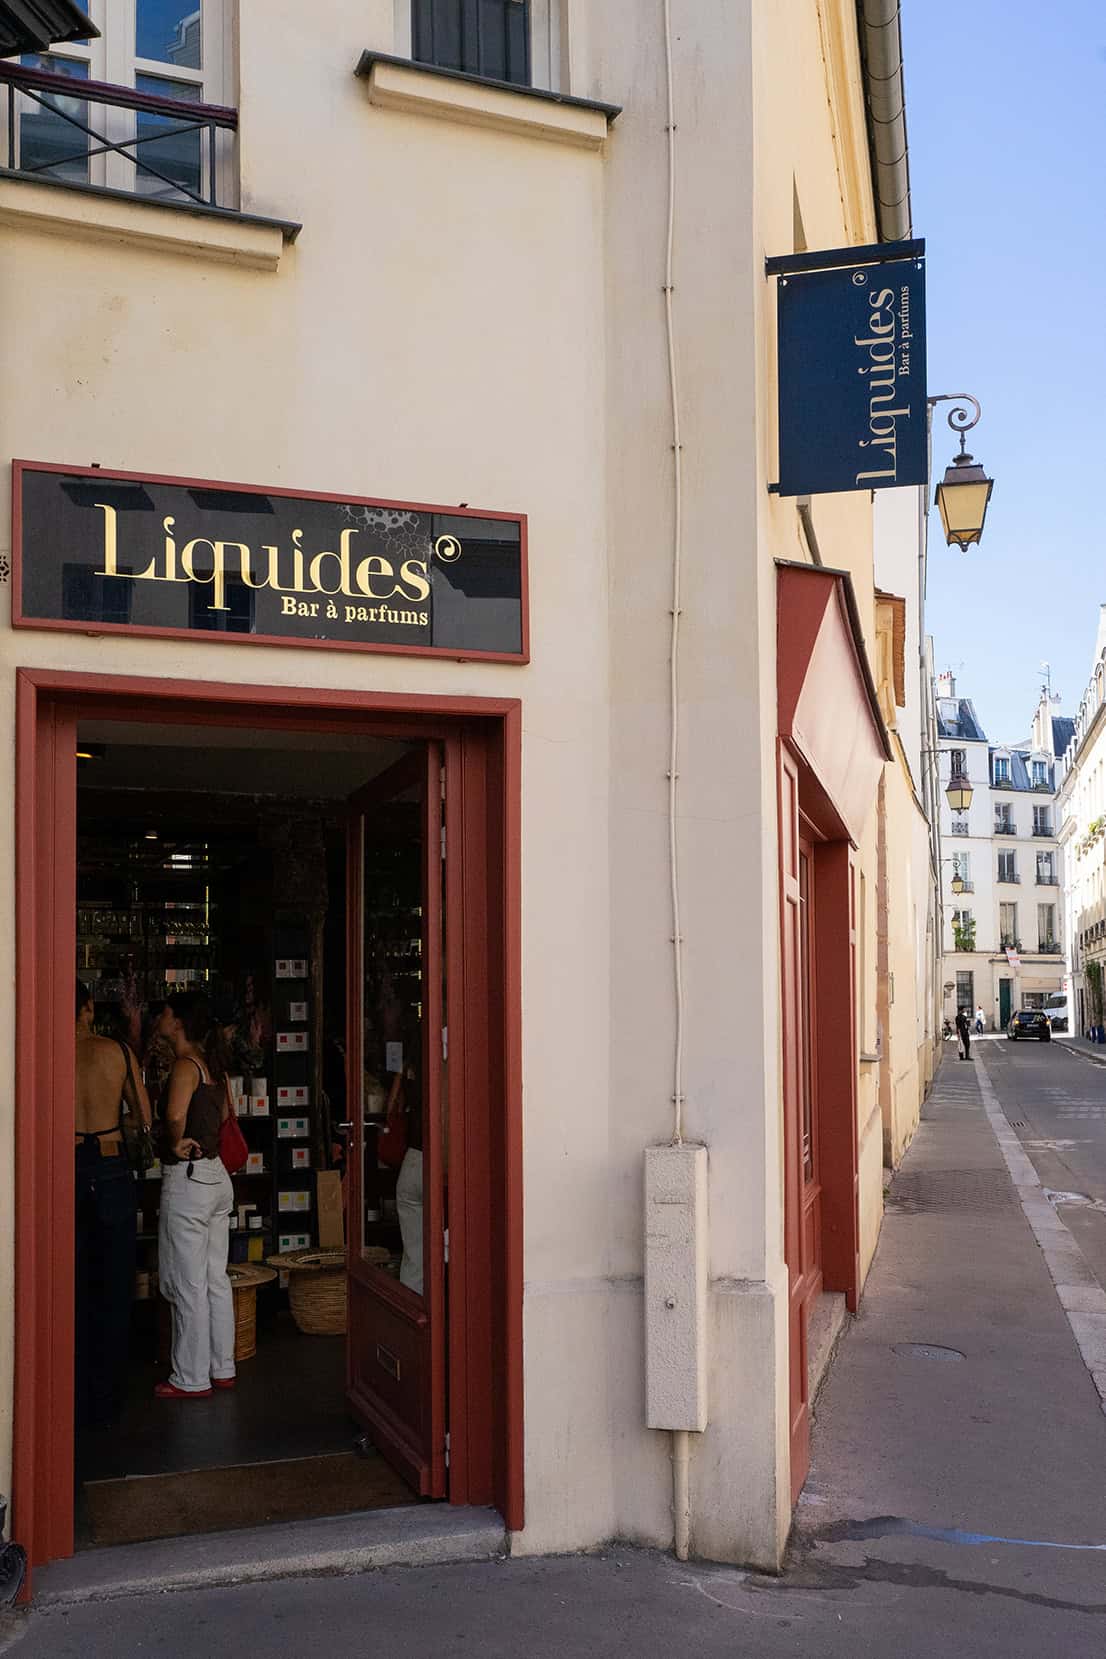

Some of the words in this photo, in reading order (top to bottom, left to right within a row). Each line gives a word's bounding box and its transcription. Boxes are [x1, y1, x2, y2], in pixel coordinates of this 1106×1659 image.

[897, 286, 913, 339] parfums
[854, 288, 911, 485] Liquides
[898, 351, 911, 376] Bar
[94, 503, 432, 611] Liquides
[280, 596, 319, 617] Bar
[326, 600, 339, 619] à
[344, 604, 429, 626] parfums
